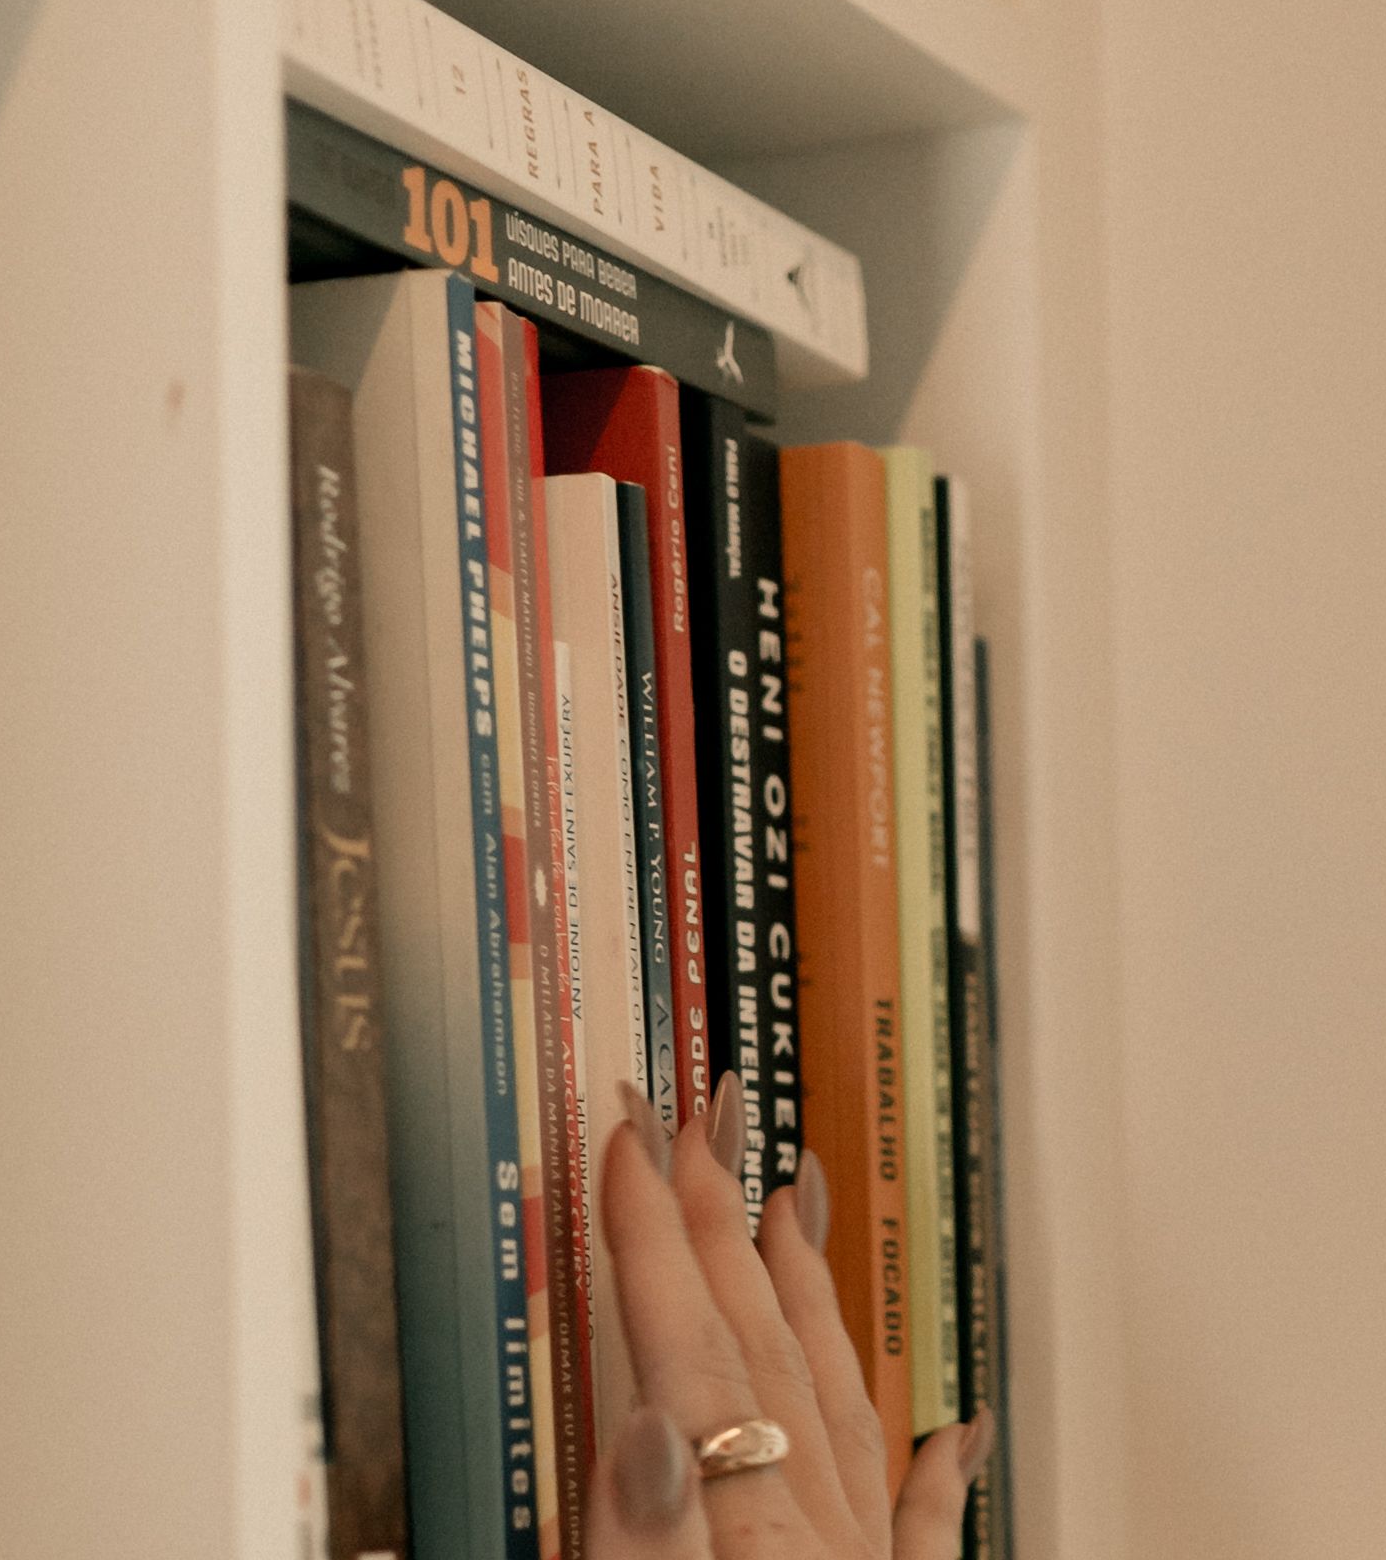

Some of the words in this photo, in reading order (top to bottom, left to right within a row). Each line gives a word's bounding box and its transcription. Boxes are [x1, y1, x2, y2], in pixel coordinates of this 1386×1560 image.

[451, 63, 467, 96] 12
[516, 67, 540, 180] REGRAS
[583, 109, 596, 127] A
[402, 165, 500, 284] 101
[586, 141, 604, 216] PARA
[648, 164, 666, 232] VIDA
[455, 329, 482, 541] MICHAEL
[666, 445, 681, 510] Ceni
[724, 438, 739, 500] PABLO
[668, 519, 686, 633] Rogério
[467, 558, 493, 737] PHELPS
[611, 574, 625, 728] ANSIEDADE
[727, 649, 748, 678] O
[757, 577, 784, 742] HENI
[618, 739, 631, 821] COMO
[729, 687, 755, 910] DESTRAVAR
[763, 773, 789, 890] OZI
[484, 833, 498, 900] Alan
[568, 882, 578, 908] DE
[622, 832, 640, 992] ENFRENTAR
[650, 853, 665, 964] YOUNG
[683, 841, 701, 985] PENAL
[570, 918, 584, 1020] ANTOINE
[736, 920, 758, 974] DA
[769, 922, 798, 1176] CUKIER
[875, 997, 899, 1183] TRABALHO
[562, 1040, 584, 1197] AUGUSTO
[496, 1160, 520, 1281] Sem
[571, 1207, 587, 1292] CURY
[880, 1216, 903, 1358] FOCADO
[504, 1317, 533, 1531] limites
